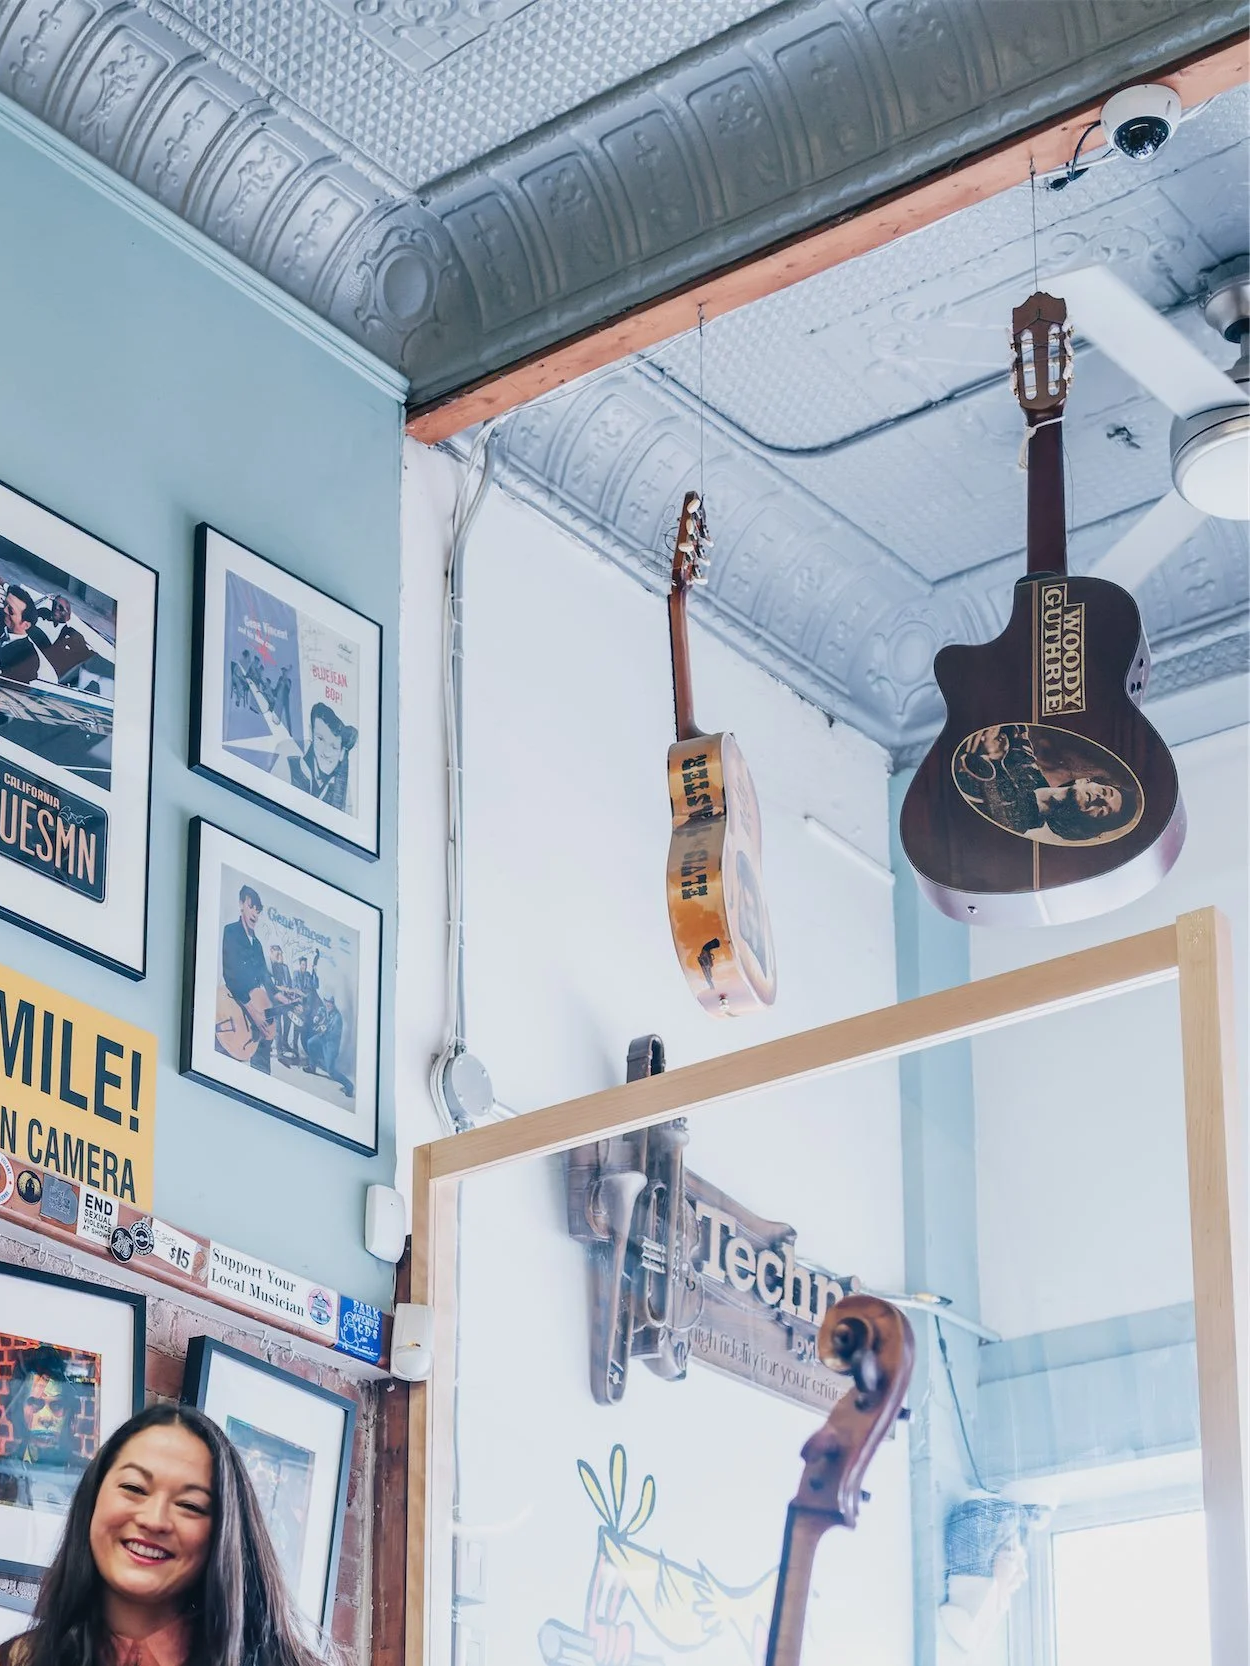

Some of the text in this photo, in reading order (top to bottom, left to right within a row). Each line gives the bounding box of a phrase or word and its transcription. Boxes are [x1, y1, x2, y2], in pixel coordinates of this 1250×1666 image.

[1043, 587, 1063, 713] GUTHRIE
[1062, 608, 1084, 714] WOODY
[3, 772, 61, 811] CALIFORNIA
[267, 906, 294, 930] Gene
[292, 916, 331, 949] Vincent
[27, 1118, 137, 1205] CAMERA
[84, 1192, 113, 1217] END
[84, 1208, 112, 1227] SEXUAL
[82, 1224, 90, 1232] AT
[83, 1216, 112, 1234] VIOLENCE
[169, 1247, 191, 1270] $15
[211, 1246, 298, 1294] Support Your
[210, 1267, 306, 1318] Local Musician
[352, 1299, 382, 1322] PARK
[760, 1350, 780, 1377] for
[780, 1364, 811, 1387] your
